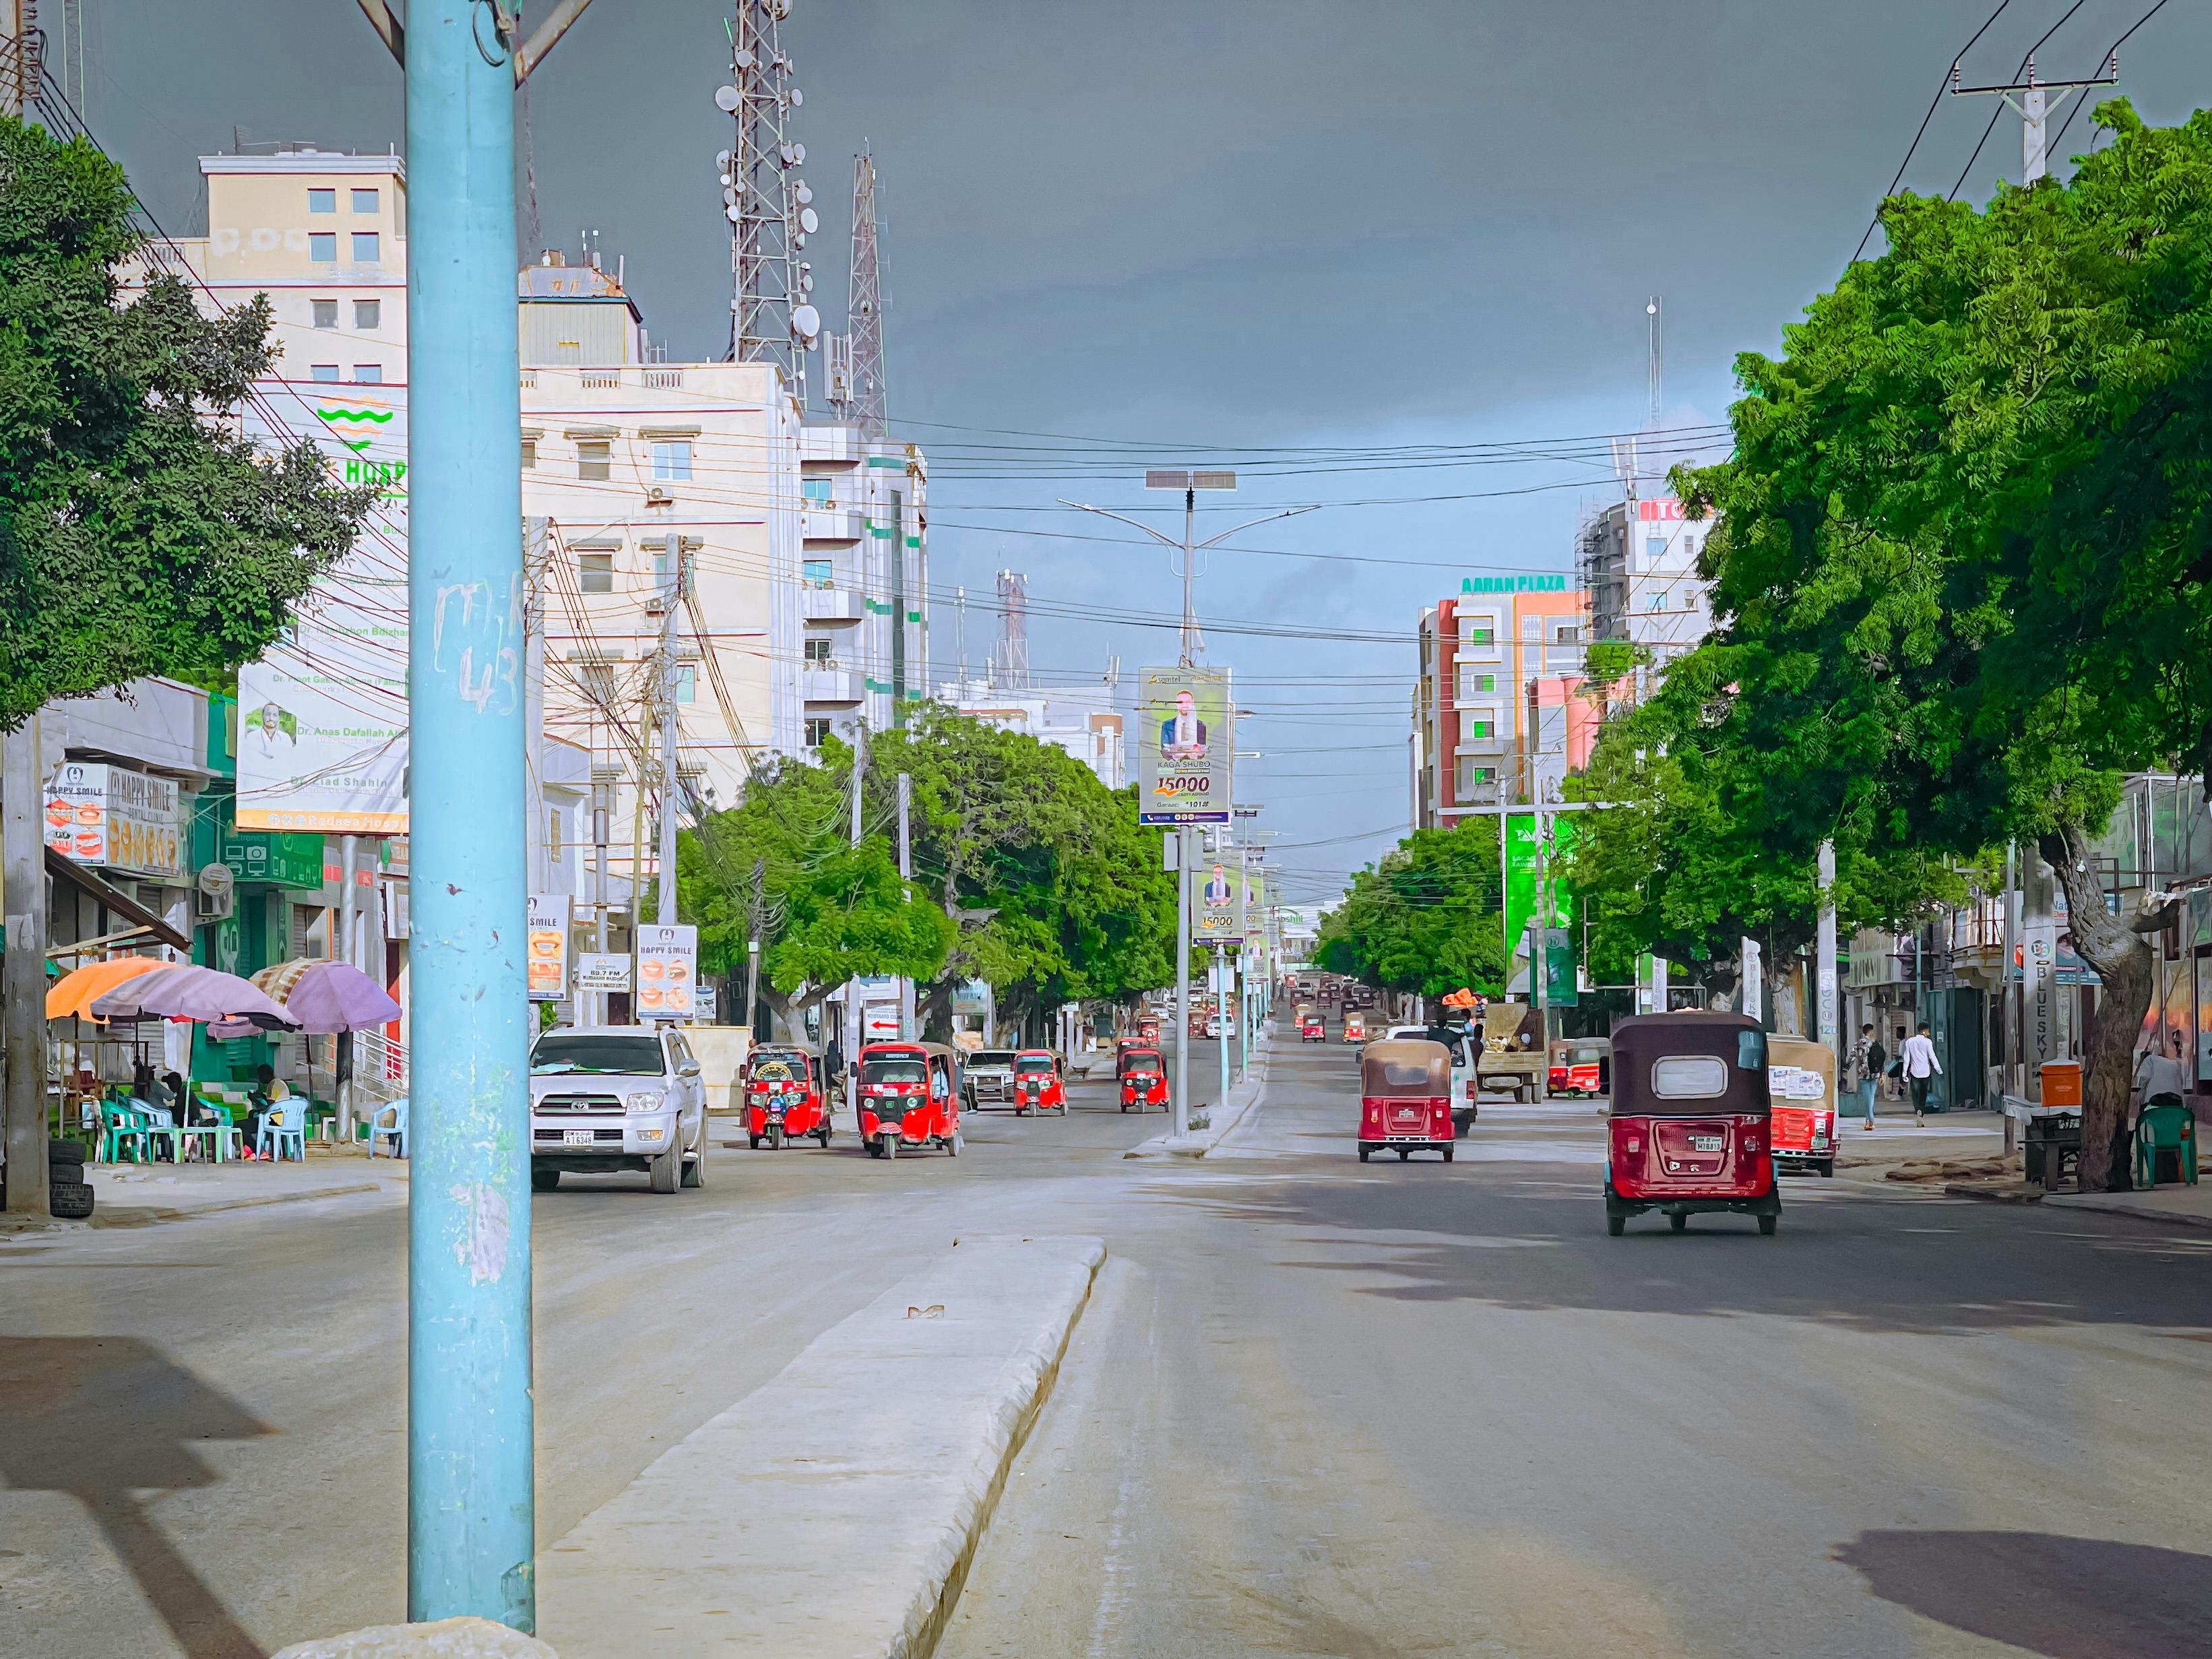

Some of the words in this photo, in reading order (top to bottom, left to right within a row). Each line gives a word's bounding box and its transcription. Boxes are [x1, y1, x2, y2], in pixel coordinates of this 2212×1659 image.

[1462, 577, 1514, 592] AARAN
[1518, 575, 1565, 592] PLAZA
[298, 727, 311, 735] Dr.
[314, 727, 340, 736] Anas
[343, 728, 384, 737] Dafallah
[344, 778, 387, 787] Shahin
[1158, 777, 1209, 792] 15000
[76, 788, 102, 796] SMILE
[121, 774, 145, 807] HAPPY
[148, 780, 170, 811] SMILE
[530, 918, 557, 927] SMILE
[2037, 967, 2047, 1017] BLUE
[2037, 1021, 2047, 1059] SKY
